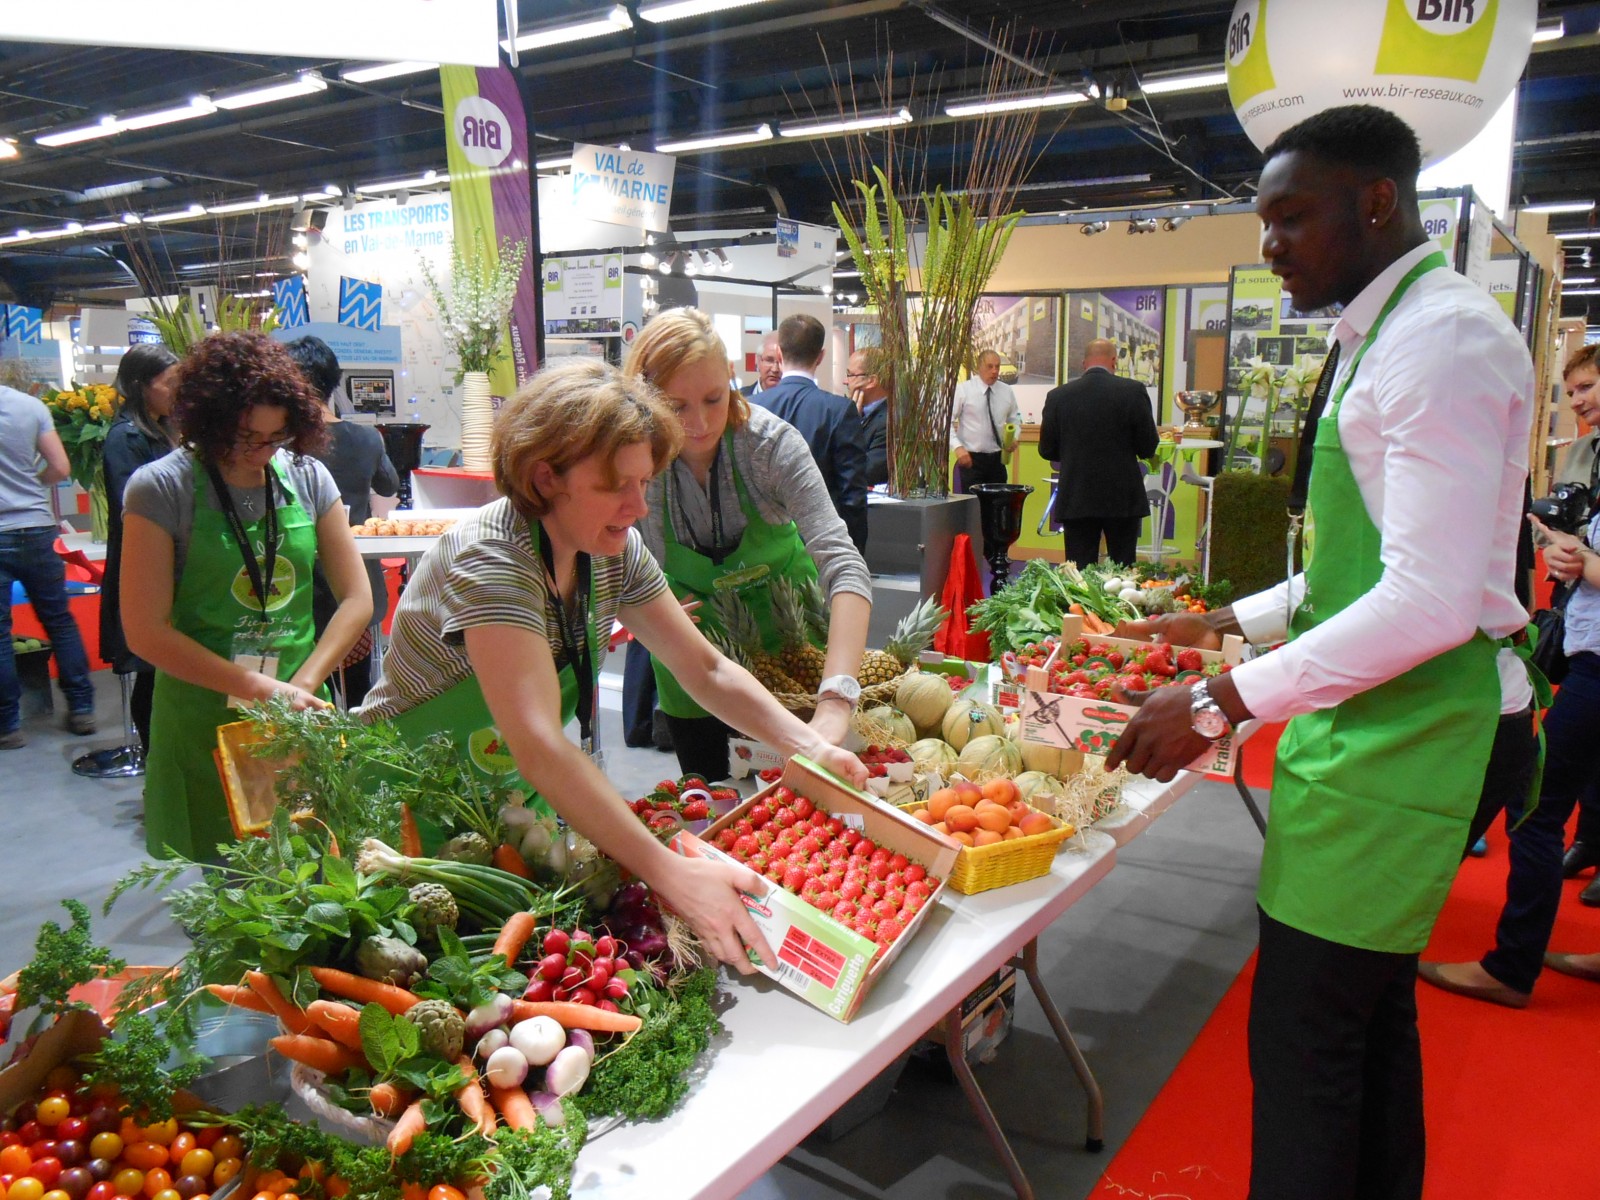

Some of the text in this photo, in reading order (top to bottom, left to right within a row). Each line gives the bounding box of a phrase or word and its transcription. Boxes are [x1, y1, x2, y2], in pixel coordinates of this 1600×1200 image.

[1343, 84, 1484, 109] www.bir-reseaux.com
[595, 152, 645, 176] VAL de
[604, 176, 668, 204] MARNE
[344, 202, 449, 232] LES TRANSPORTS
[344, 239, 358, 254] en
[828, 953, 865, 1014] Gariguette
